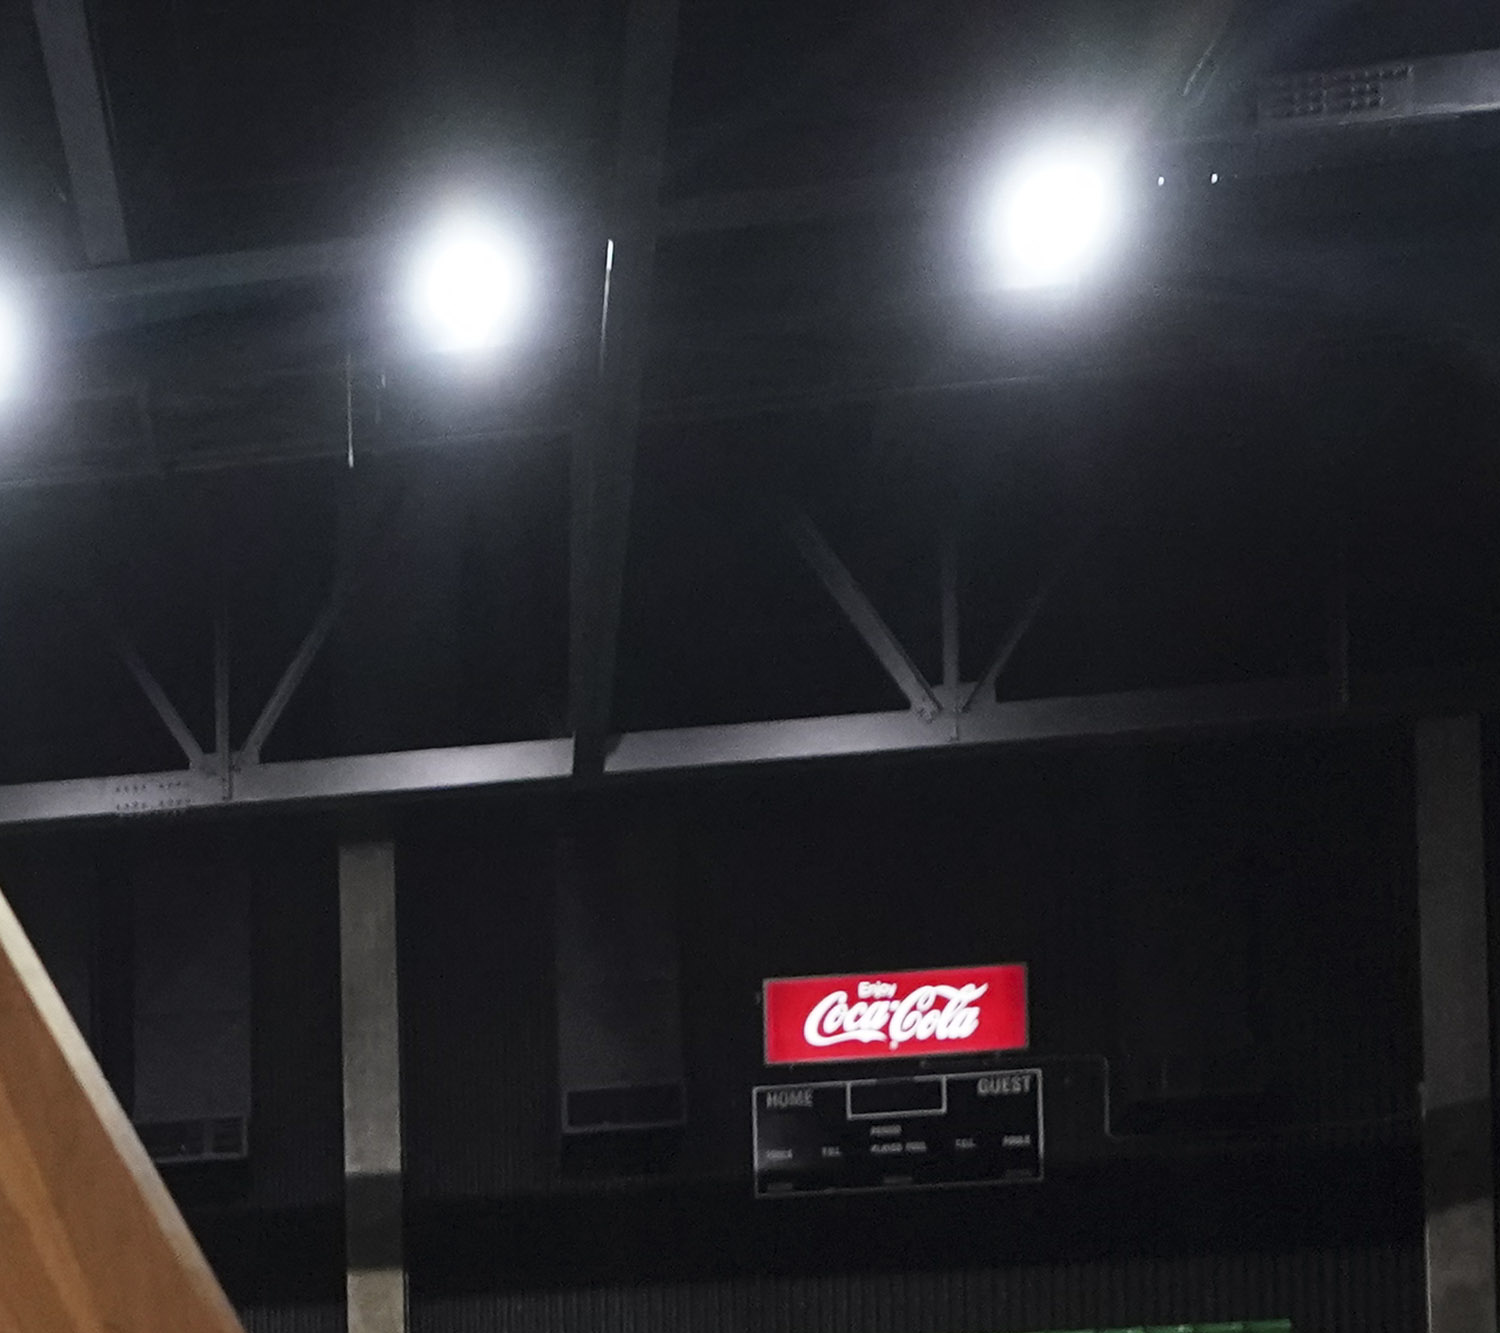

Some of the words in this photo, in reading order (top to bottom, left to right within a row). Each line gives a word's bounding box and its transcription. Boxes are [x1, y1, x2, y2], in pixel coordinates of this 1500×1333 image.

[857, 981, 898, 1000] Enjoy
[977, 1075, 1032, 1096] GUEST
[766, 1089, 814, 1108] HOME
